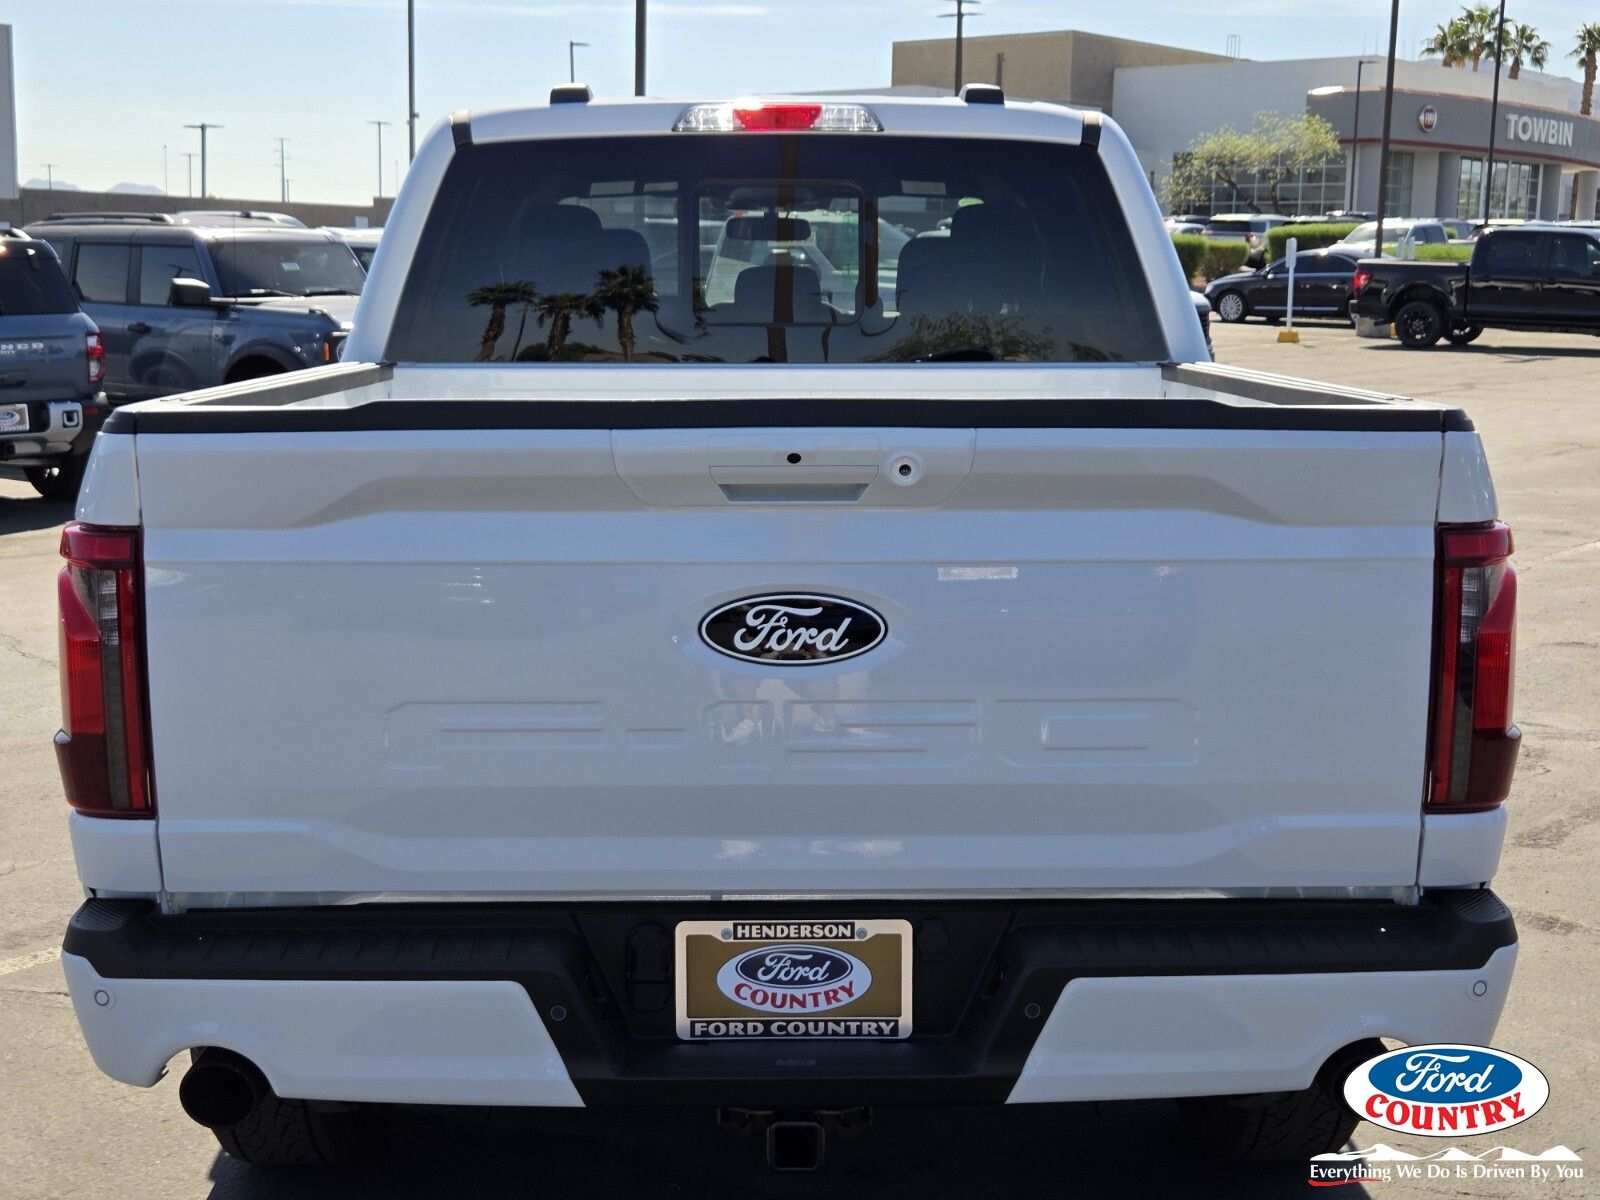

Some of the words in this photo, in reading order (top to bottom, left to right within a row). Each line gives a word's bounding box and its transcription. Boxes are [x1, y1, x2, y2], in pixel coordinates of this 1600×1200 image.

[1505, 113, 1573, 147] TOWBIN
[733, 604, 852, 652] Ford
[736, 924, 852, 939] HENDERSON
[757, 952, 831, 982] Ford
[734, 980, 855, 1010] COUNTRY
[694, 1022, 765, 1036] FORD
[770, 1021, 896, 1036] COUNTRY
